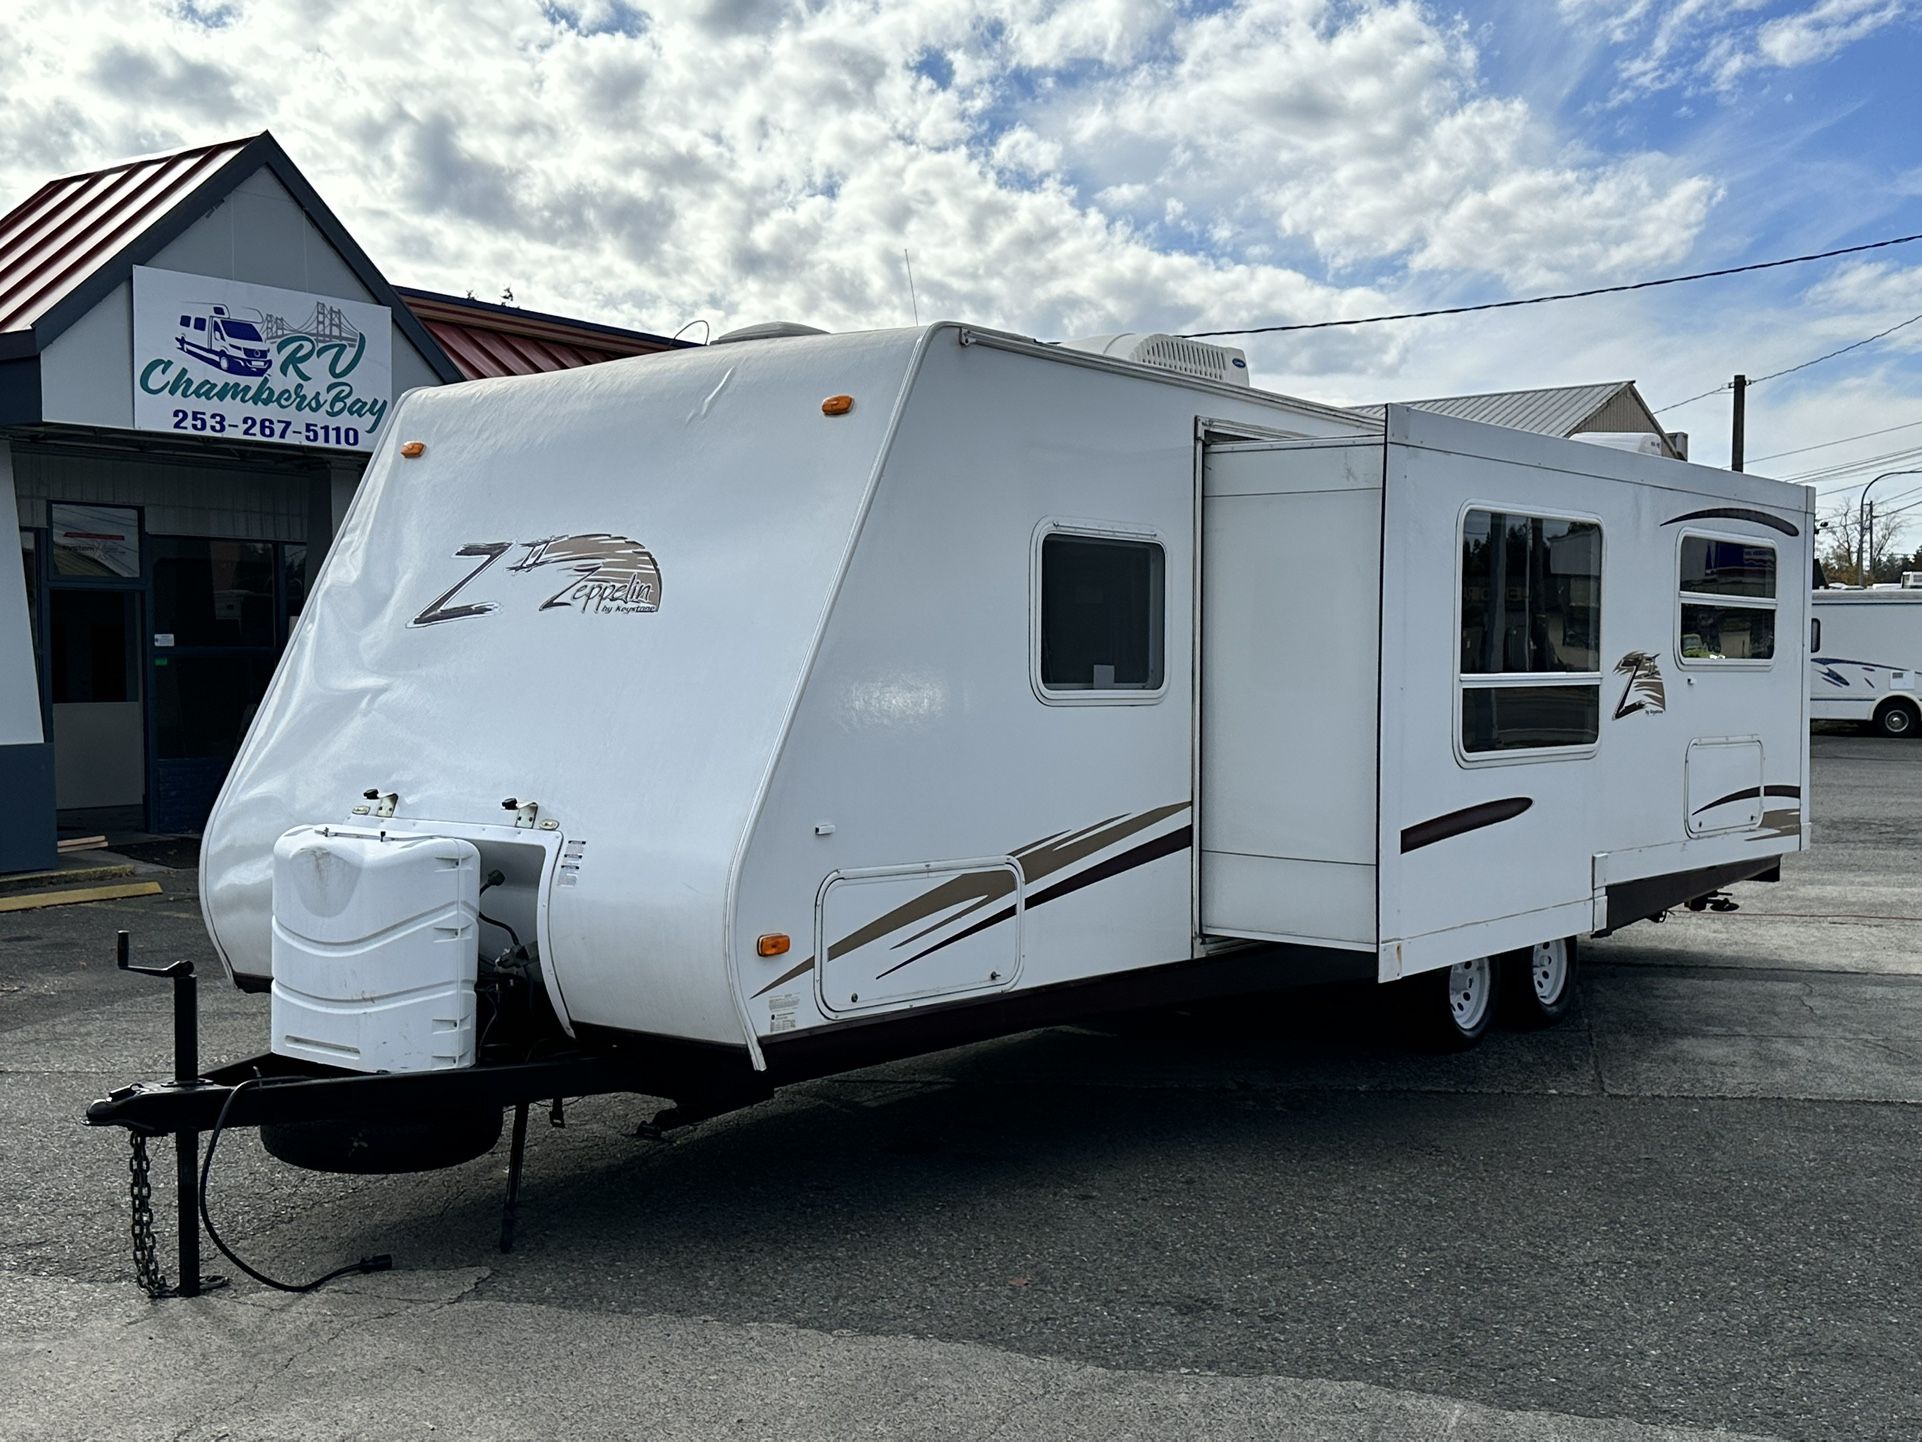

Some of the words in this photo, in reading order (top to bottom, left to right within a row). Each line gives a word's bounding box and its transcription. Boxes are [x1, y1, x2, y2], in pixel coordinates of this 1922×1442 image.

[276, 332, 366, 382] RV
[172, 409, 359, 446] 253-267-5110
[539, 562, 653, 613] Zeppelin
[601, 605, 613, 614] by
